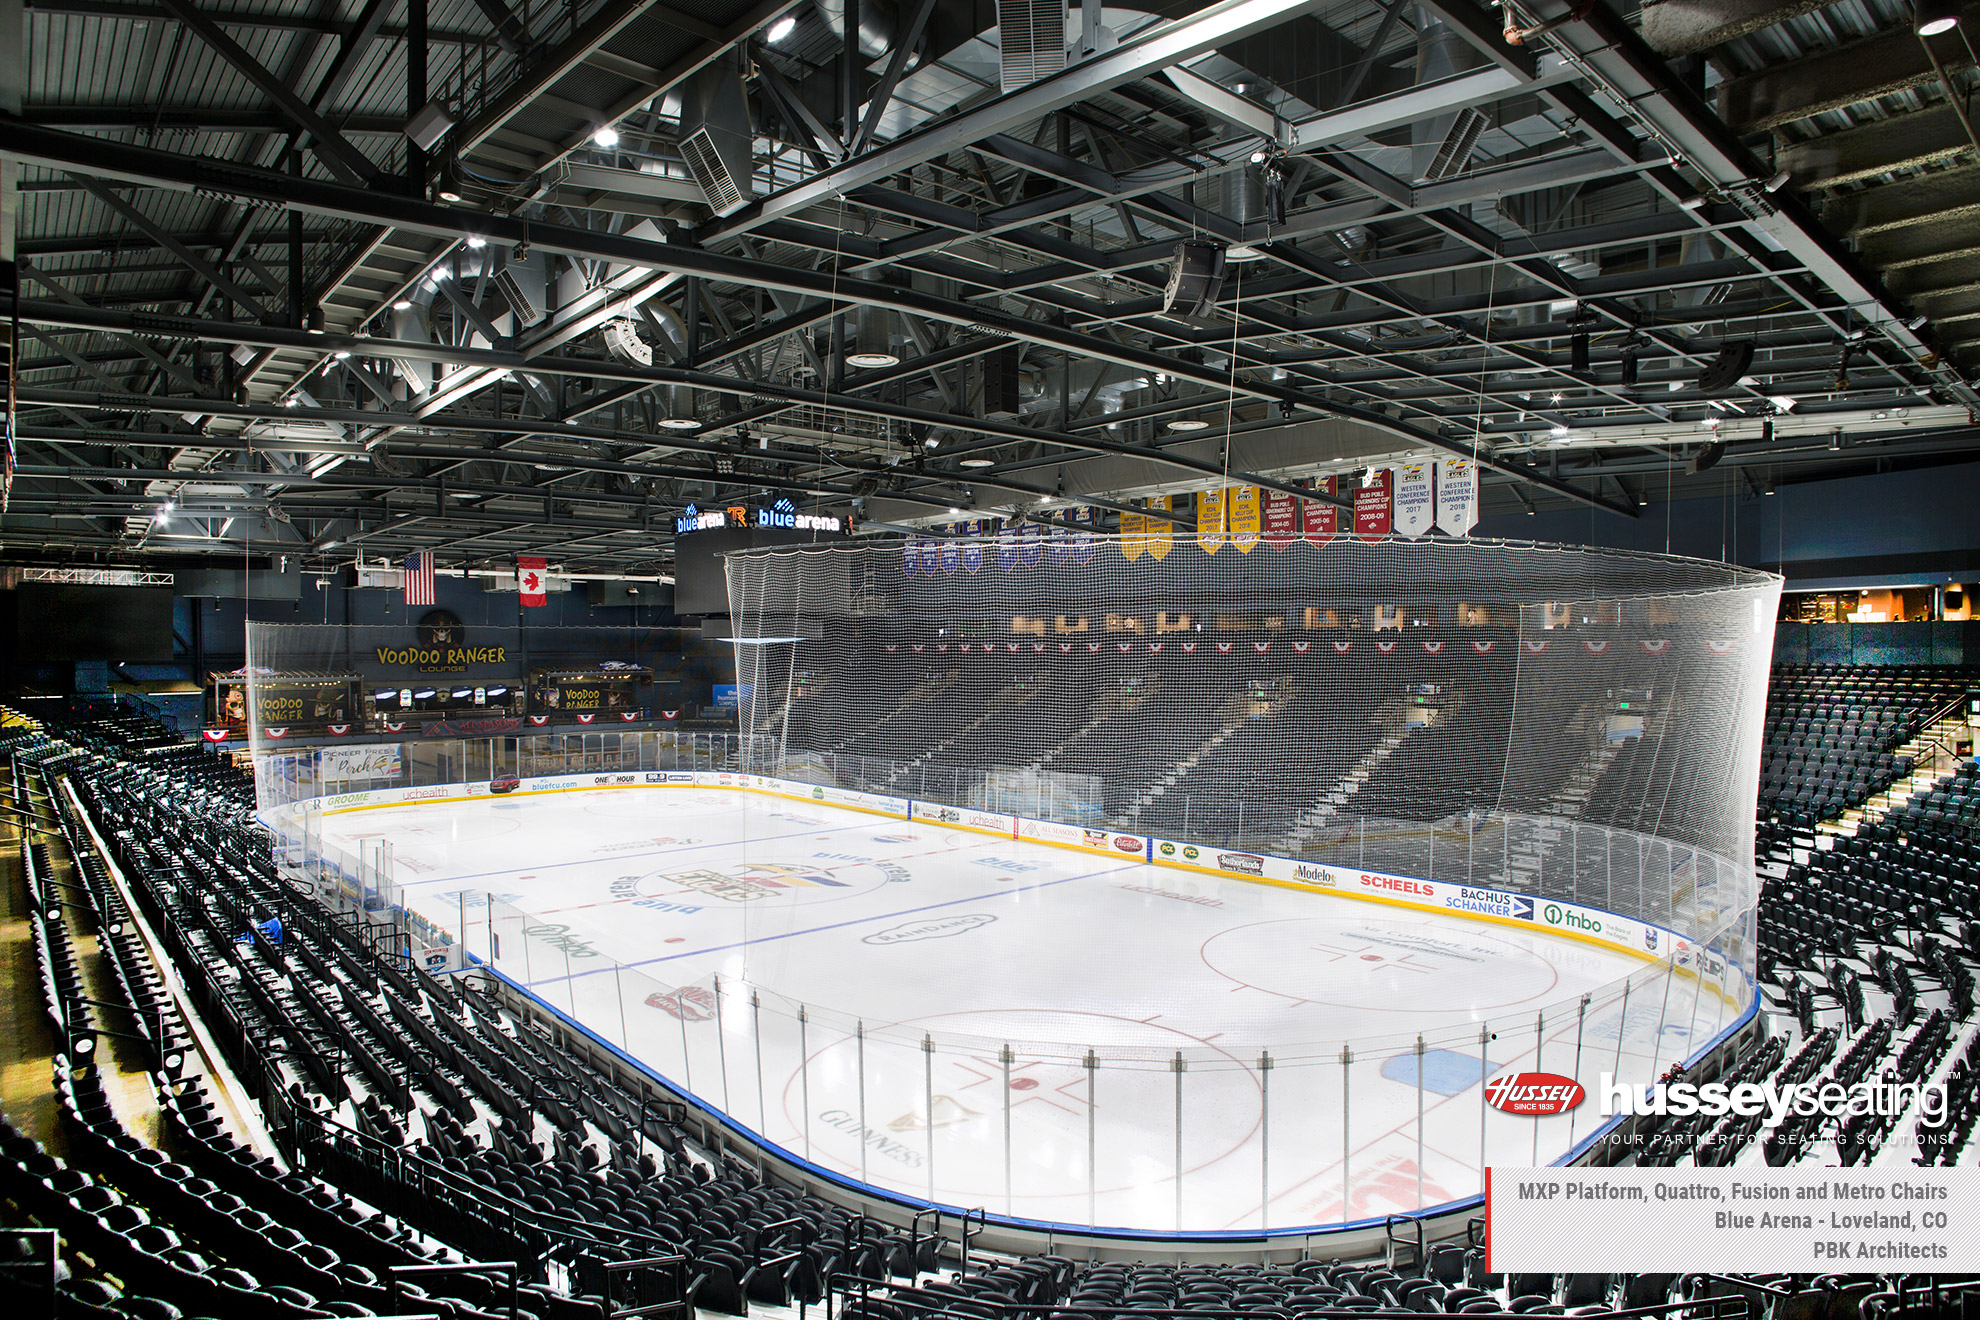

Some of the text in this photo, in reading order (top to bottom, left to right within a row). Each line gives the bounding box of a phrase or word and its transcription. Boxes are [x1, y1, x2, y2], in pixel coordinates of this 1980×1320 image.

[1401, 484, 1426, 492] WESTERN
[1445, 481, 1471, 489] WESTERN
[1397, 490, 1430, 499] CONFERENCE
[1440, 488, 1474, 496] CONFERENCE
[1397, 497, 1429, 505] CHAMPIONS
[1441, 495, 1474, 503] CHAMPIONS
[1306, 509, 1333, 517] CHAMPIONS
[1357, 503, 1387, 512] CHAMPIONS
[377, 647, 506, 665] VOODOO RANGER
[419, 665, 466, 673] LOUNGE
[565, 689, 600, 700] VOODOO
[256, 697, 303, 710] VOODOO
[257, 709, 304, 723] RANGER
[460, 719, 519, 729] ALL SEASONS
[338, 755, 370, 775] Perch
[594, 775, 635, 784] ONE HOUR
[532, 780, 578, 791] bluefcu.com
[327, 792, 370, 806] GROOME
[402, 786, 449, 801] uchealth
[968, 813, 1005, 830] uchealth
[1052, 827, 1078, 837] SEASONS
[1162, 845, 1174, 853] PCL
[1185, 849, 1197, 857] PCL
[1297, 865, 1331, 882] Modelo
[1360, 874, 1434, 896] SCHEELS
[1461, 888, 1510, 905] BACHUS
[1445, 897, 1510, 917] SCHANKER
[1565, 910, 1602, 933] fnbo
[880, 916, 987, 943] RAINDANCE
[819, 1109, 923, 1169] GUINNESS
